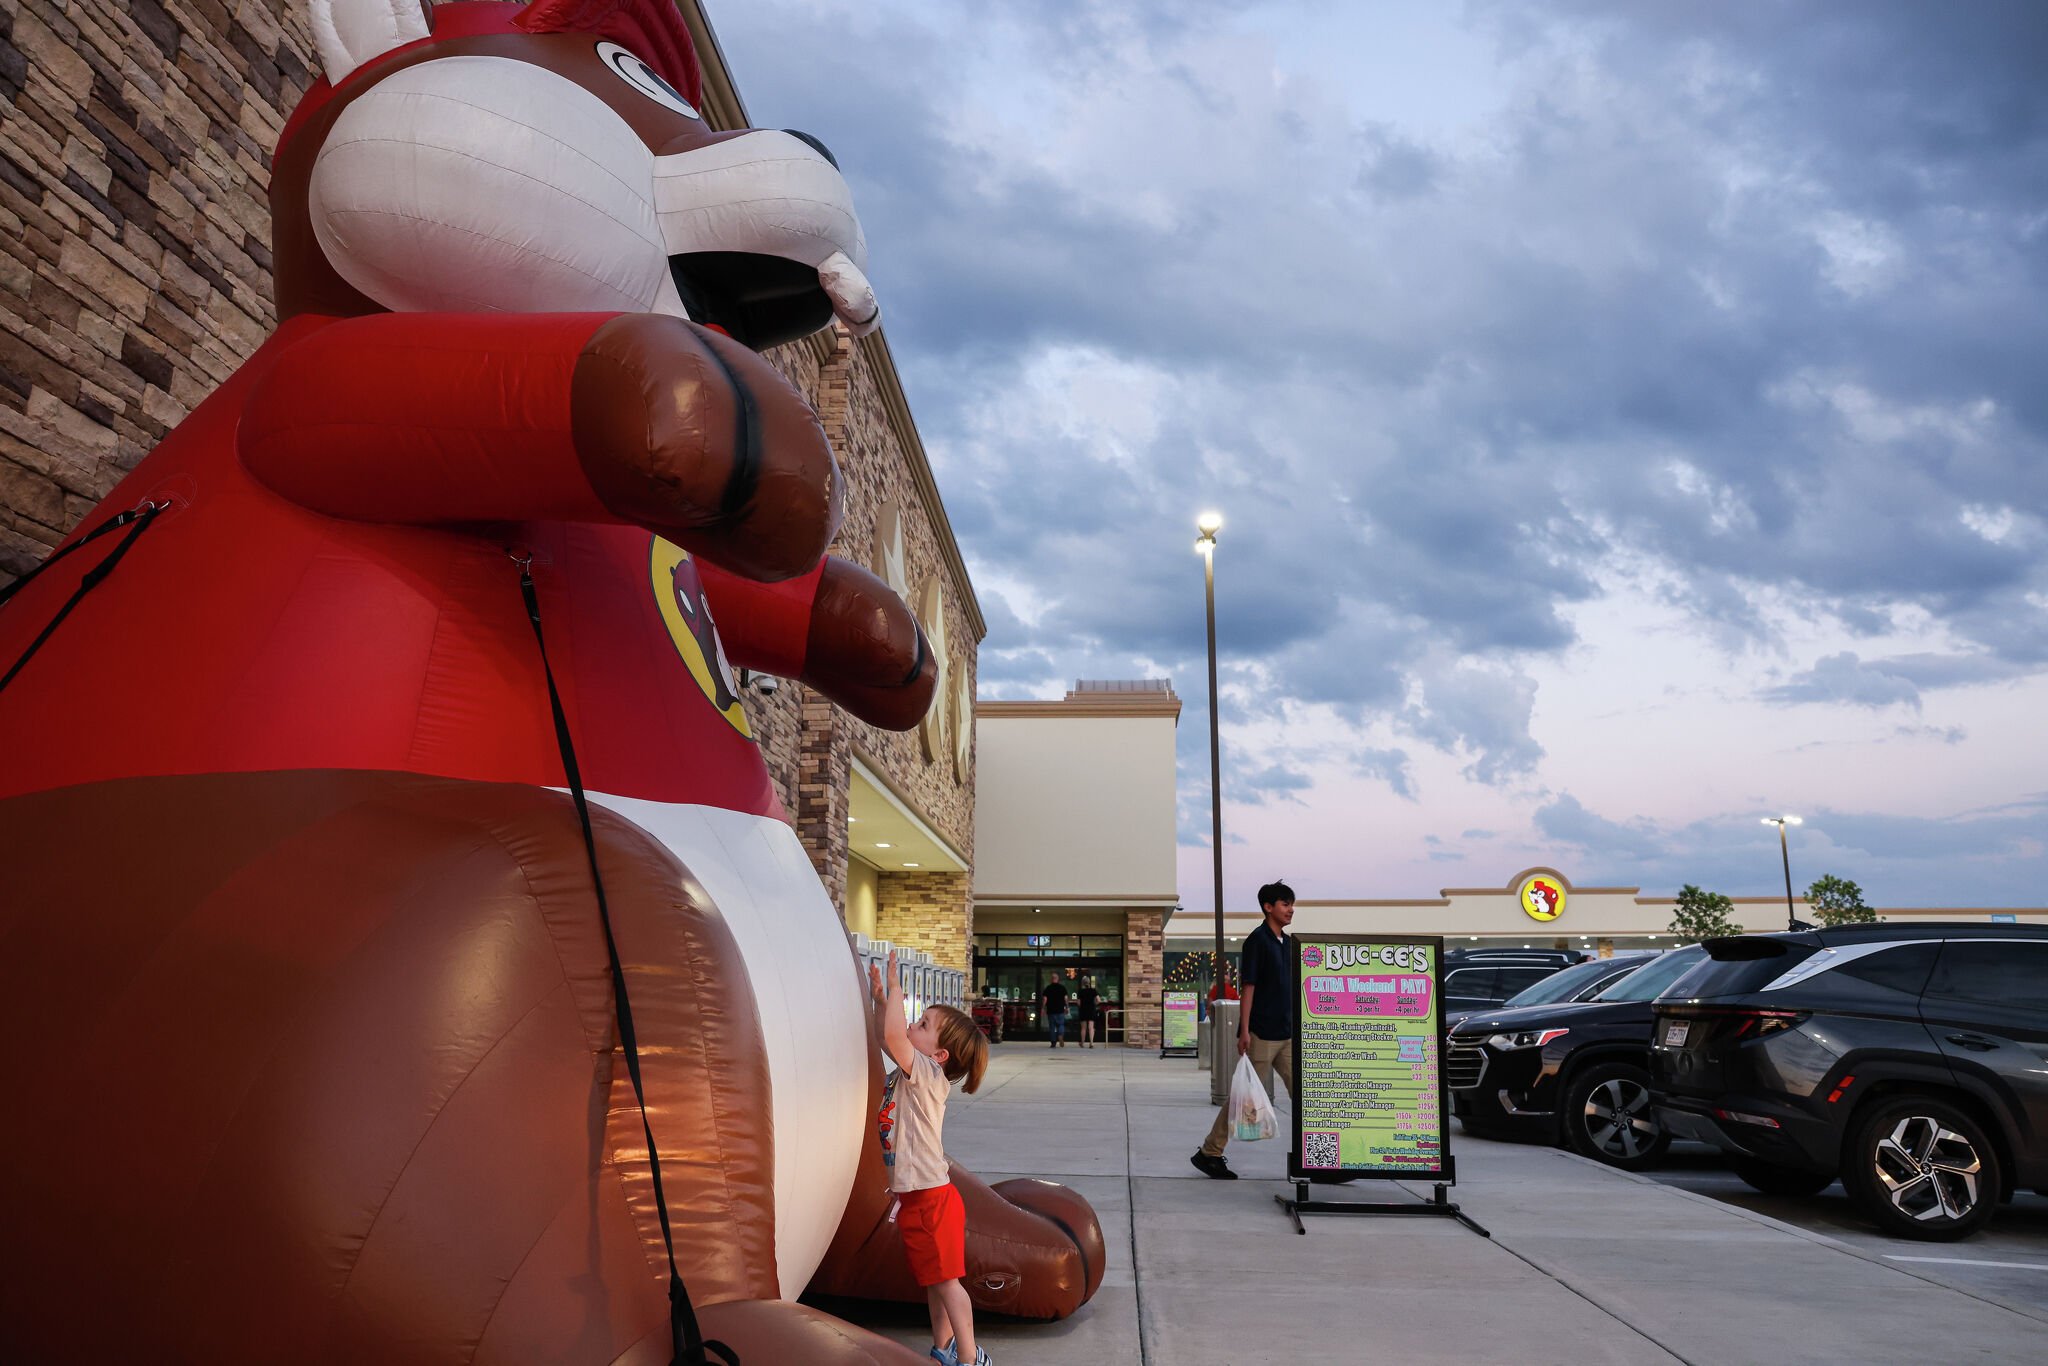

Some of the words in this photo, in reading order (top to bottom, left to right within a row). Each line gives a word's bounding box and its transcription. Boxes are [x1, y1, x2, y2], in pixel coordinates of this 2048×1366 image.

[1325, 944, 1429, 973] BUC-EE'S
[1310, 976, 1345, 992] EXTRA
[1347, 978, 1396, 994] Weekend
[1400, 978, 1427, 994] PAY!
[1318, 994, 1336, 1003] Friday:
[1356, 996, 1380, 1004] Saturday:
[1397, 996, 1418, 1004] Sunday:
[1302, 1022, 1326, 1031] Cashier,
[1326, 1022, 1339, 1031] Gift,
[1302, 1032, 1336, 1040] Warehouse,
[1348, 1032, 1370, 1042] Grocery
[1302, 1041, 1329, 1050] Restroom
[1330, 1042, 1345, 1050] Crew
[1302, 1051, 1317, 1060] Food
[1318, 1051, 1338, 1060] Service
[1339, 1052, 1350, 1060] and
[1351, 1052, 1360, 1060] Car
[1361, 1052, 1377, 1060] Wash
[1302, 1061, 1318, 1069] Team
[1318, 1061, 1332, 1069] Lead
[1302, 1070, 1336, 1080] Department
[1336, 1071, 1362, 1080] Manager
[1302, 1080, 1330, 1088] Assistant
[1345, 1081, 1366, 1089] Service
[1367, 1082, 1392, 1091] Manager
[1302, 1090, 1330, 1098] Assistant
[1330, 1090, 1352, 1098] General
[1353, 1091, 1378, 1100] Manager
[1302, 1100, 1314, 1108] Gift
[1314, 1100, 1352, 1110] Manager/Car
[1369, 1101, 1394, 1111] Manager
[1302, 1110, 1316, 1118] Food
[1318, 1110, 1338, 1118] Service
[1340, 1110, 1365, 1120] Manager
[1302, 1119, 1324, 1127] General
[1325, 1120, 1350, 1130] Manager
